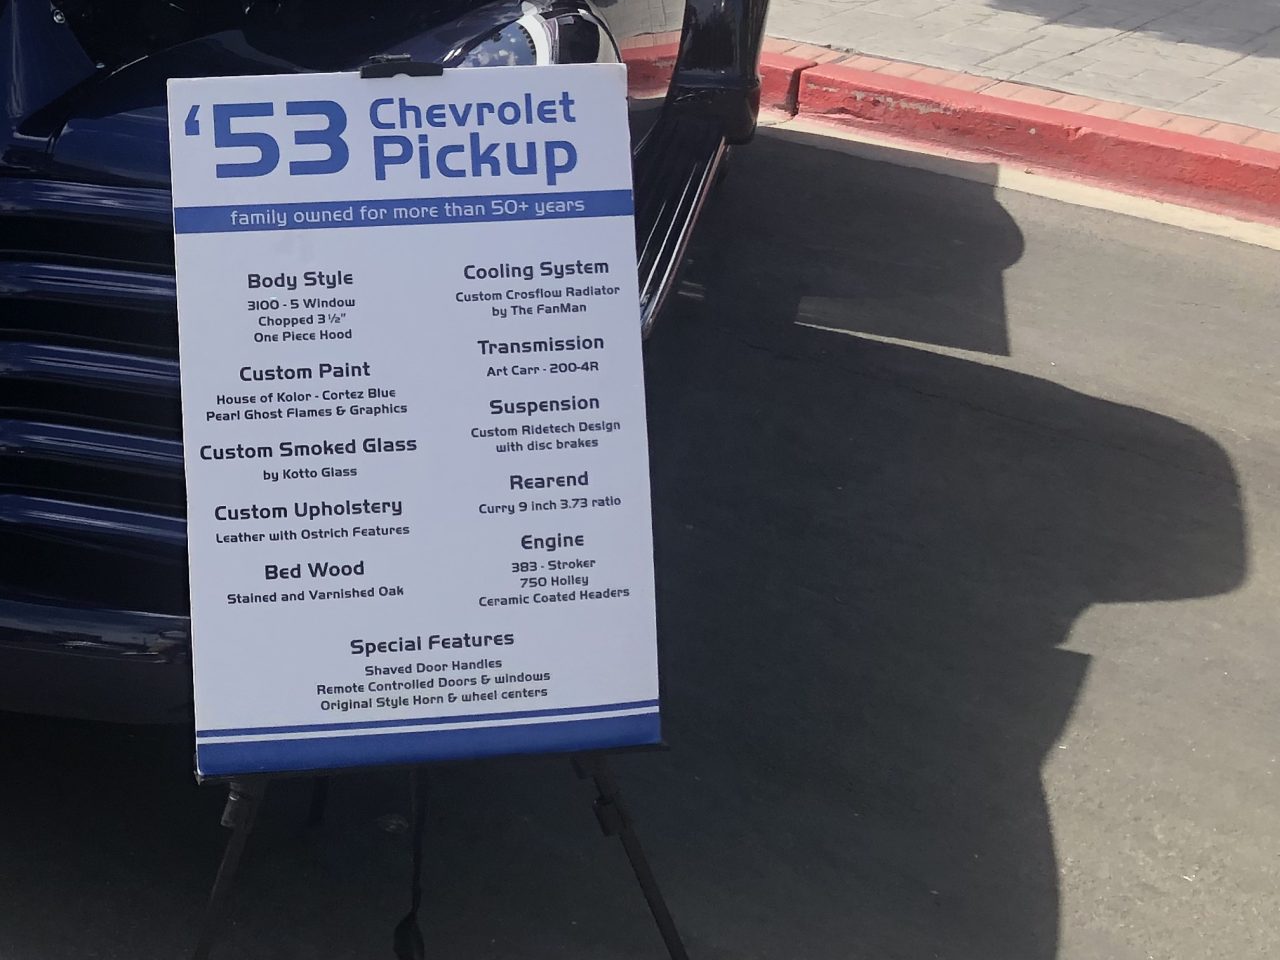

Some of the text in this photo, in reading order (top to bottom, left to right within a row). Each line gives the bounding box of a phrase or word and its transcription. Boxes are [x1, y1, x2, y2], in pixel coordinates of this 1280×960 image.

[370, 92, 576, 129] Chevrolet
[373, 132, 577, 186] Pickup
[231, 200, 584, 226] family owned for more than 50+ years
[464, 260, 609, 280] Cooling System
[248, 270, 353, 290] Body Style
[456, 285, 620, 302] Custom Crosflow Radiator
[248, 297, 355, 311] 3100 5 Window
[492, 303, 586, 318] by The FanMan
[259, 314, 313, 328] Chopped
[317, 314, 325, 324] 3
[254, 329, 352, 342] One Piece Hood
[477, 335, 604, 355] Transmission
[240, 362, 370, 381] Custom Paint
[487, 361, 599, 376] Art Carr 200-4R
[217, 388, 396, 405] House of Kolor Cortez Blue
[490, 395, 599, 416] Suspension
[206, 404, 407, 421] Pearl Ghost Flames & Graphics
[471, 421, 620, 437] Custom Ridetech Design
[200, 438, 417, 460] Custom Smoked Glass
[496, 438, 598, 452] with disc brakes
[263, 467, 357, 482] by Kotto Glass
[510, 471, 588, 490] Rearend
[215, 499, 402, 520] Custom Upholstery
[479, 496, 621, 515] Curry 9 inch 3.73 ratio
[216, 526, 410, 543] Leather with Ostrich Features
[521, 533, 584, 552] Engine
[265, 560, 364, 580] Bed Wood
[512, 558, 596, 572] 383 Stroker
[520, 575, 588, 588] 750 Holley
[227, 586, 404, 604] Stained and Varnished Oak
[479, 588, 630, 606] Ceramic Coated Headers
[350, 633, 514, 657] Special Features
[365, 659, 502, 676] Shaved Door Handles
[317, 672, 550, 695] Remote Controlled Doors & windows
[321, 688, 547, 712] Original Style Horn & wheel centers
